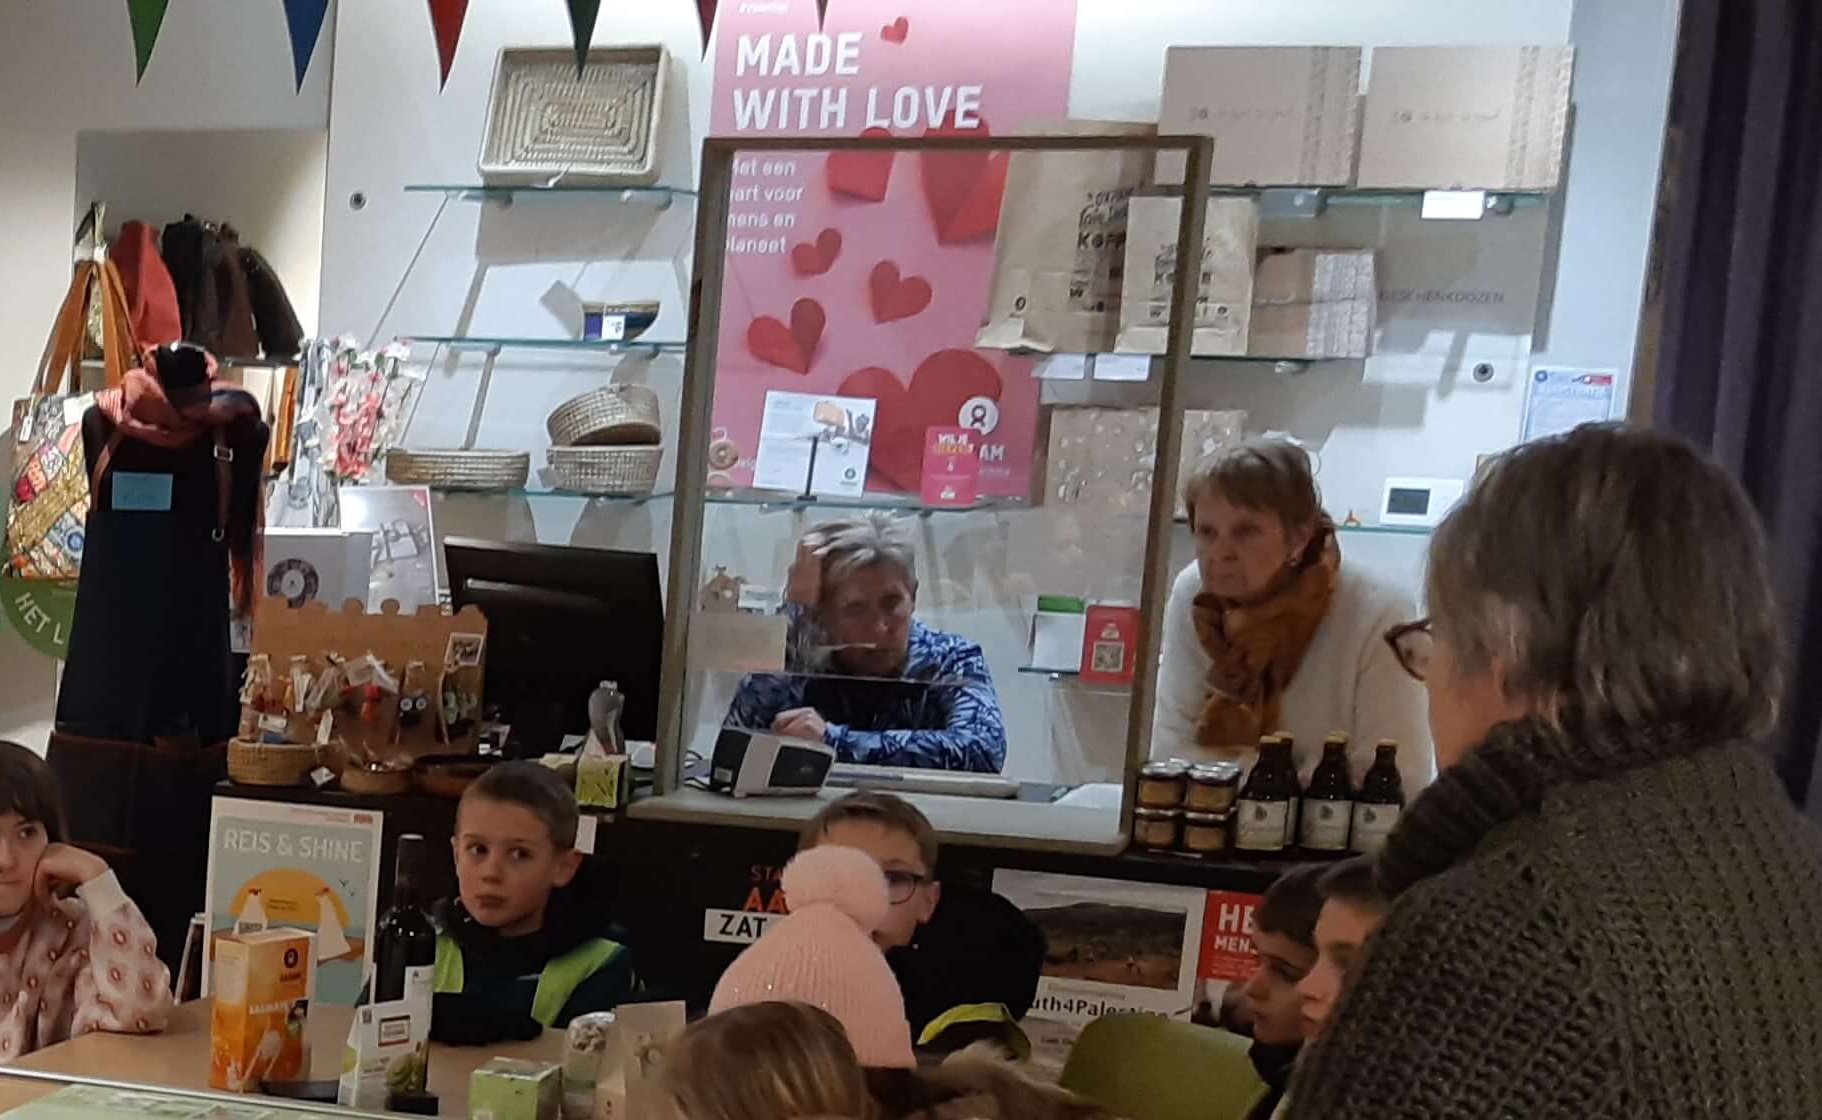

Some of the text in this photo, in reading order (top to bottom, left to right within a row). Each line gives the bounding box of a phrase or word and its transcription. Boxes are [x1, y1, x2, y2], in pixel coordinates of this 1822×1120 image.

[734, 31, 863, 77] MADE
[732, 84, 983, 131] WITH LOVE
[14, 591, 52, 633] HET
[224, 828, 364, 864] REIS & SHINE
[742, 886, 790, 915] AA
[1218, 902, 1256, 935] HE
[1213, 935, 1258, 955] MEN
